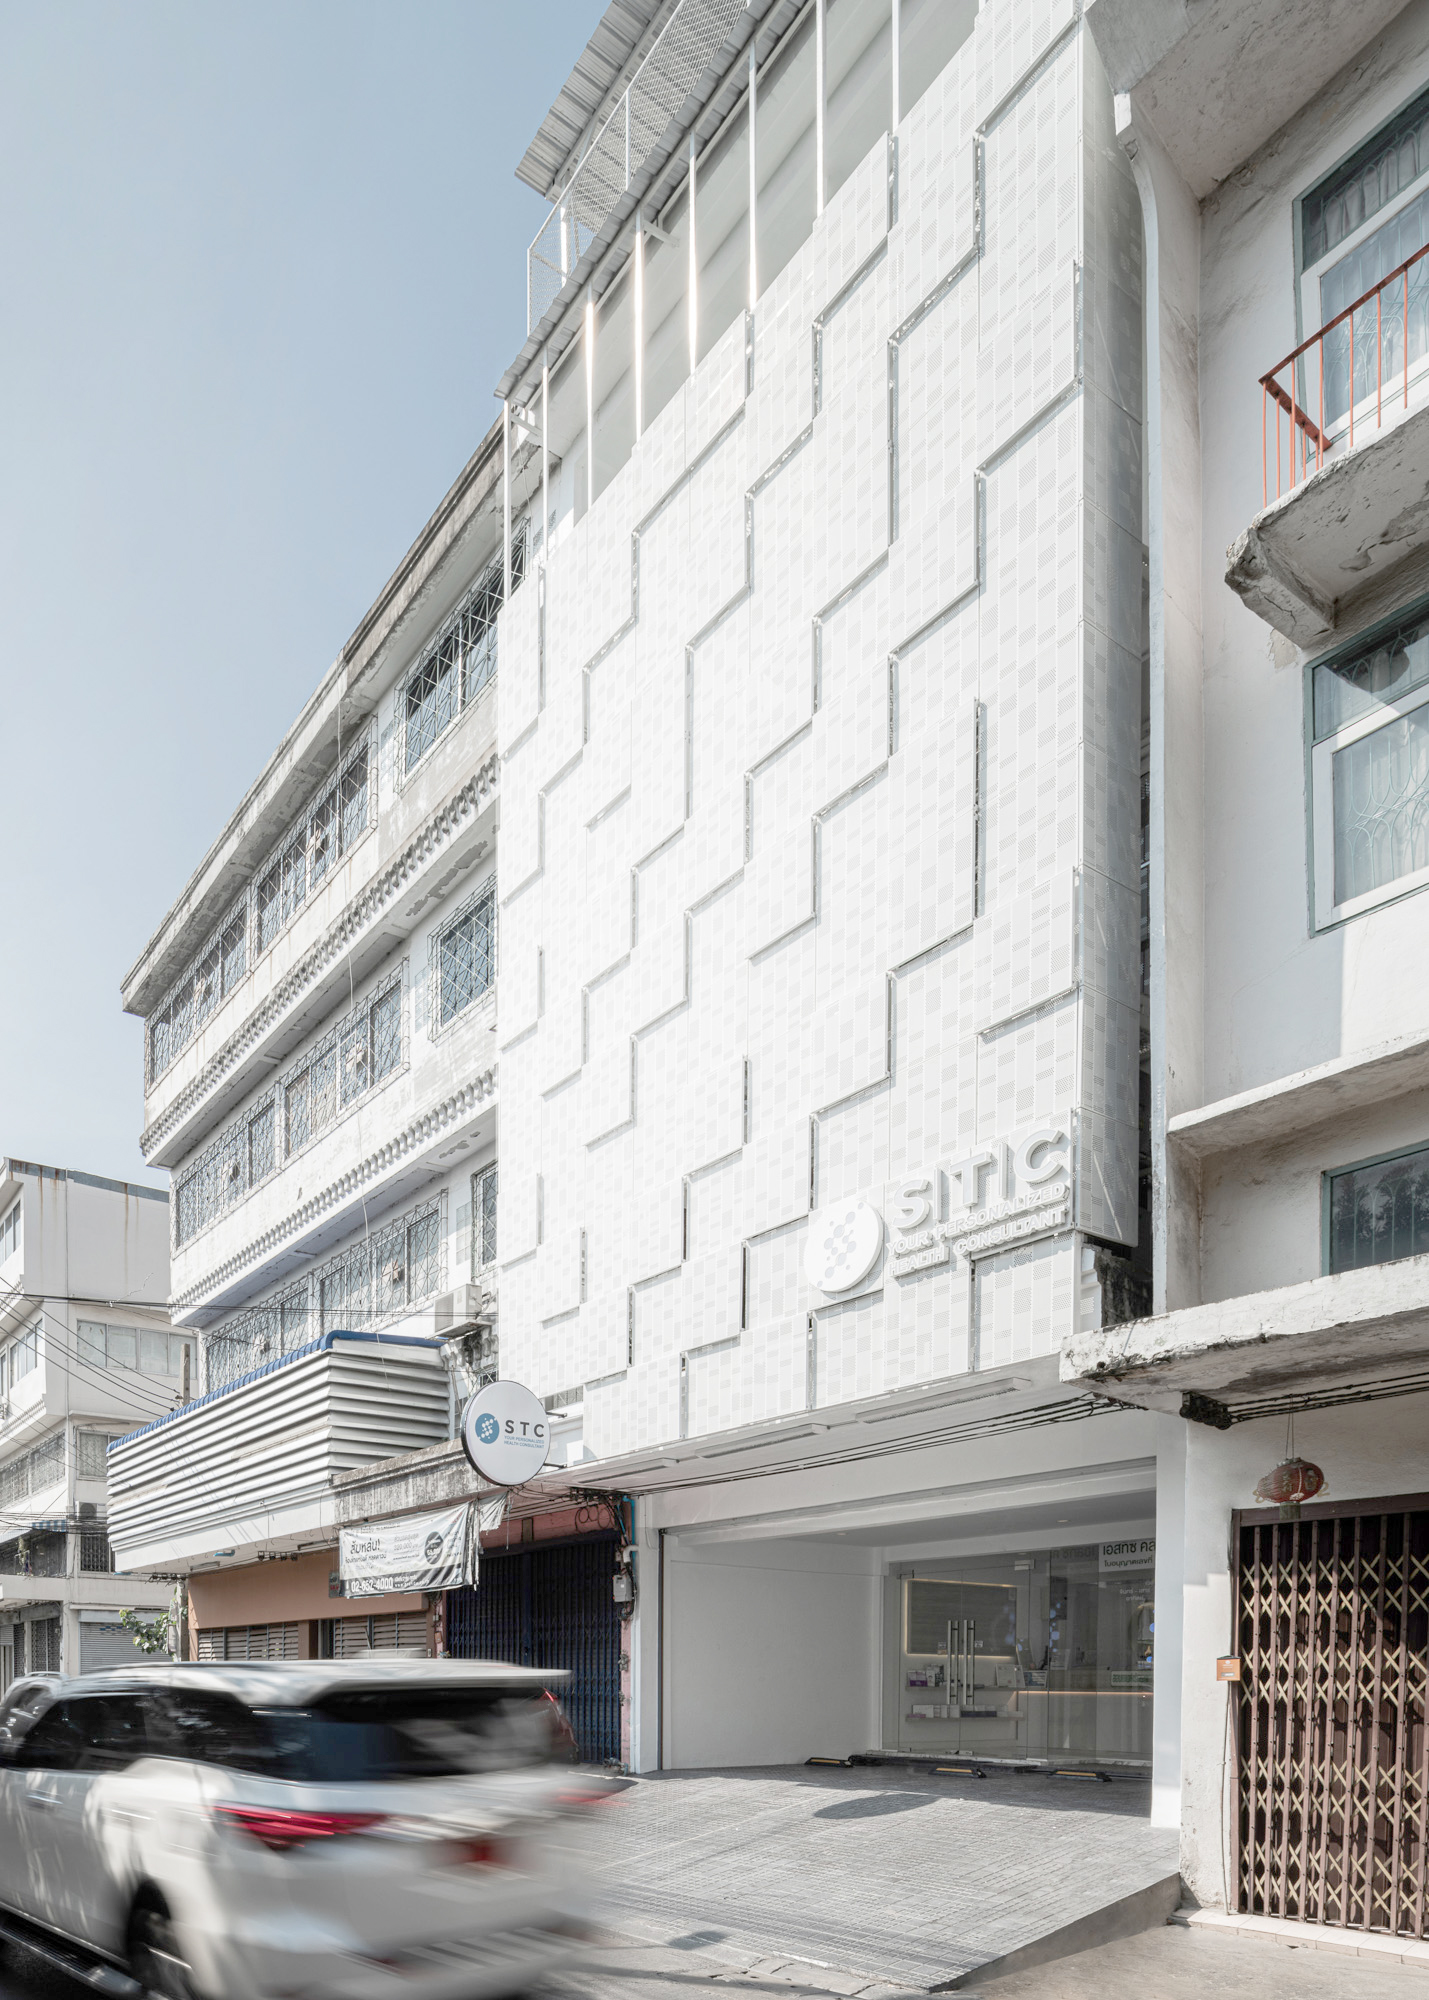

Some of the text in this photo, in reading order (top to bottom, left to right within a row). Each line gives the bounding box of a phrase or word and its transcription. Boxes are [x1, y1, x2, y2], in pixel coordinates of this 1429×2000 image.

[886, 1182, 1070, 1256] YOUR PERSONALIZED
[888, 1205, 1069, 1277] HEALTH CONSULTANT
